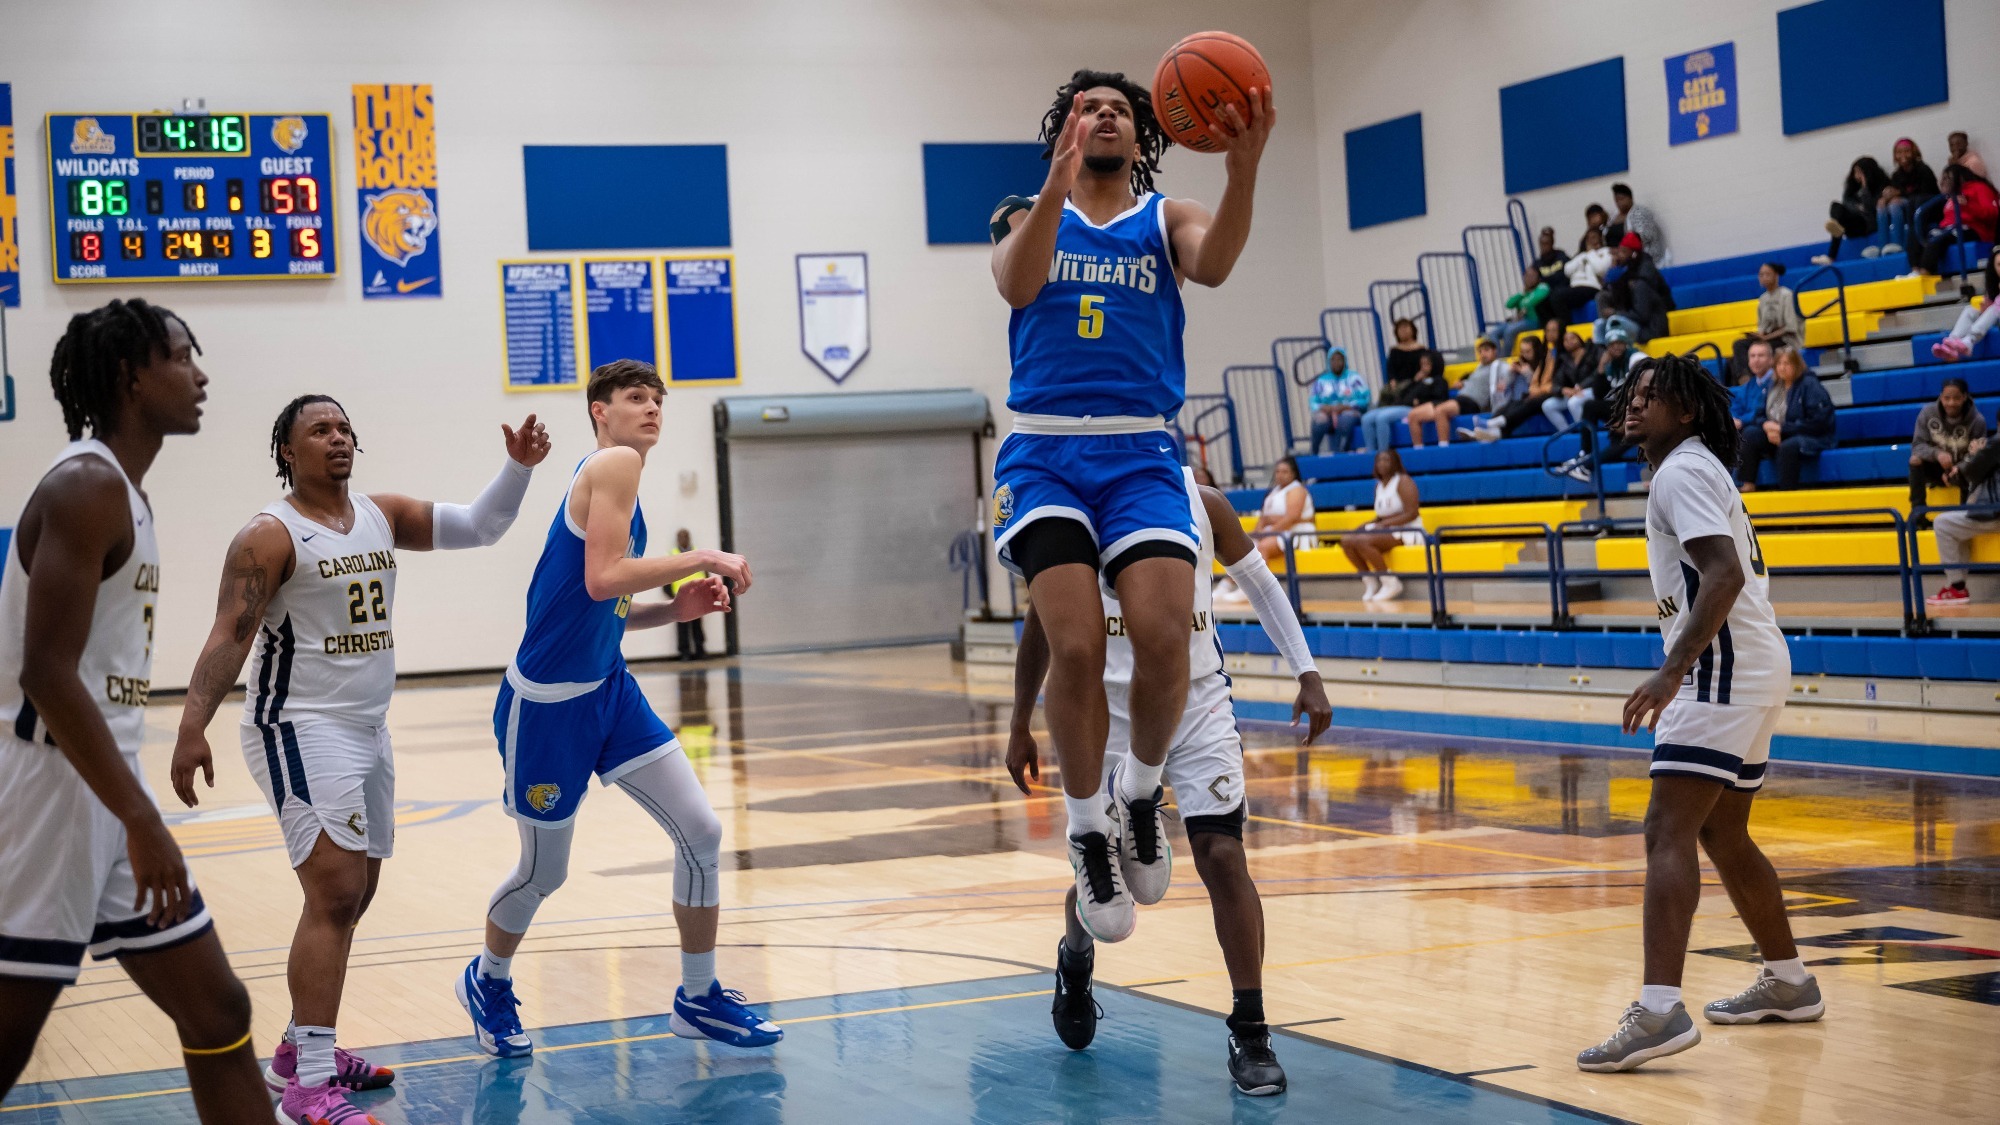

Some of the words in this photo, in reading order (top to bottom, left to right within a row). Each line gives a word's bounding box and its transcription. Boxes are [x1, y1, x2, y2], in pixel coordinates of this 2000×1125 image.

[352, 84, 434, 128] THIS
[162, 116, 244, 151] 4:16
[354, 128, 376, 158] IS
[380, 128, 436, 160] OUR
[56, 157, 140, 177] WILDCATS
[173, 166, 215, 180] PERIOD
[260, 156, 314, 175] GUEST
[356, 157, 438, 189] HOUSE
[80, 179, 129, 215] 86
[271, 177, 318, 214] 57
[67, 218, 105, 232] FOULS
[116, 217, 148, 231] T.O.L.
[157, 217, 201, 231] PLAYER
[205, 216, 235, 230] FOUL
[245, 215, 276, 229] T.O.L.
[286, 215, 323, 229] FOULS
[82, 234, 100, 260] 8
[124, 236, 142, 258] 4
[253, 228, 271, 258] 3
[299, 227, 319, 258] 5
[69, 264, 107, 278] SCORE
[179, 262, 219, 275] MATCH
[288, 260, 325, 274] SCORE
[1048, 250, 1157, 295] WILDCATS
[1077, 294, 1105, 339] 5
[318, 549, 397, 579] CAROLINA
[346, 578, 388, 625] 22
